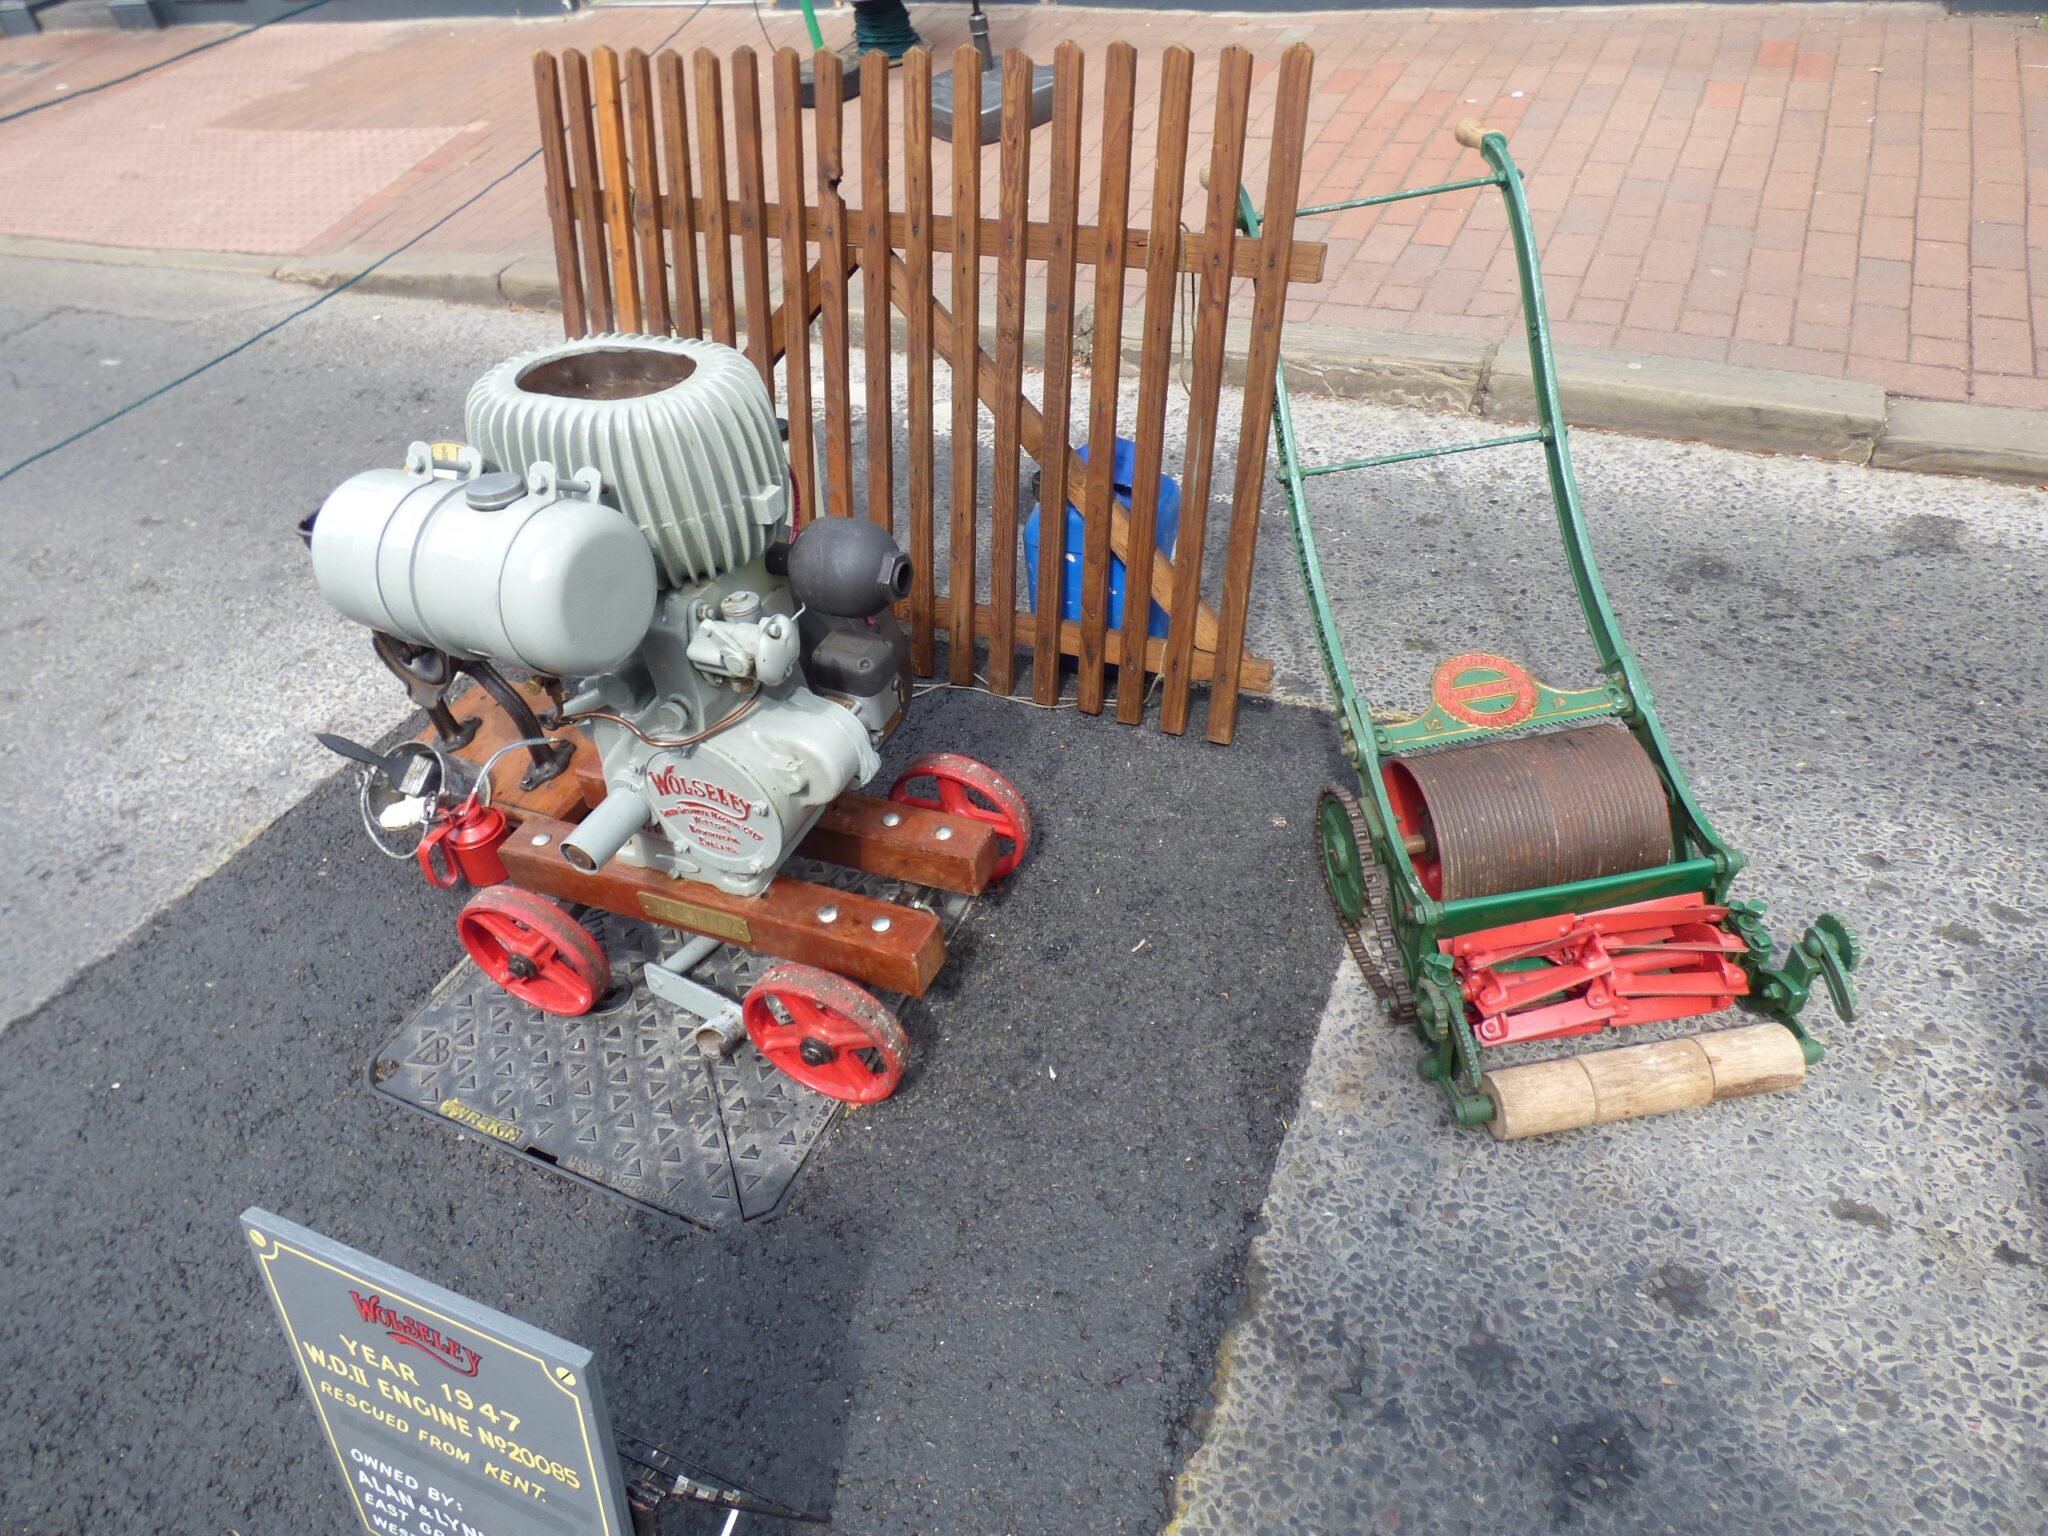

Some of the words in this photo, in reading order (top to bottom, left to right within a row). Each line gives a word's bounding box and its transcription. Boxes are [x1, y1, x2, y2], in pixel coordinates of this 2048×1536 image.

[648, 764, 751, 820] WOLSELEY
[348, 1289, 483, 1378] WOLSELEY
[339, 1334, 420, 1387] YEAR
[441, 1383, 521, 1433] 1947
[377, 1377, 474, 1438] ENGINE
[320, 1380, 410, 1433] RESCUED
[418, 1429, 471, 1464] FROM
[484, 1462, 547, 1503] KENT.
[350, 1447, 419, 1490] OWNED
[427, 1486, 464, 1512] BY:
[358, 1469, 416, 1510] ALAN
[364, 1492, 410, 1522] EAST
